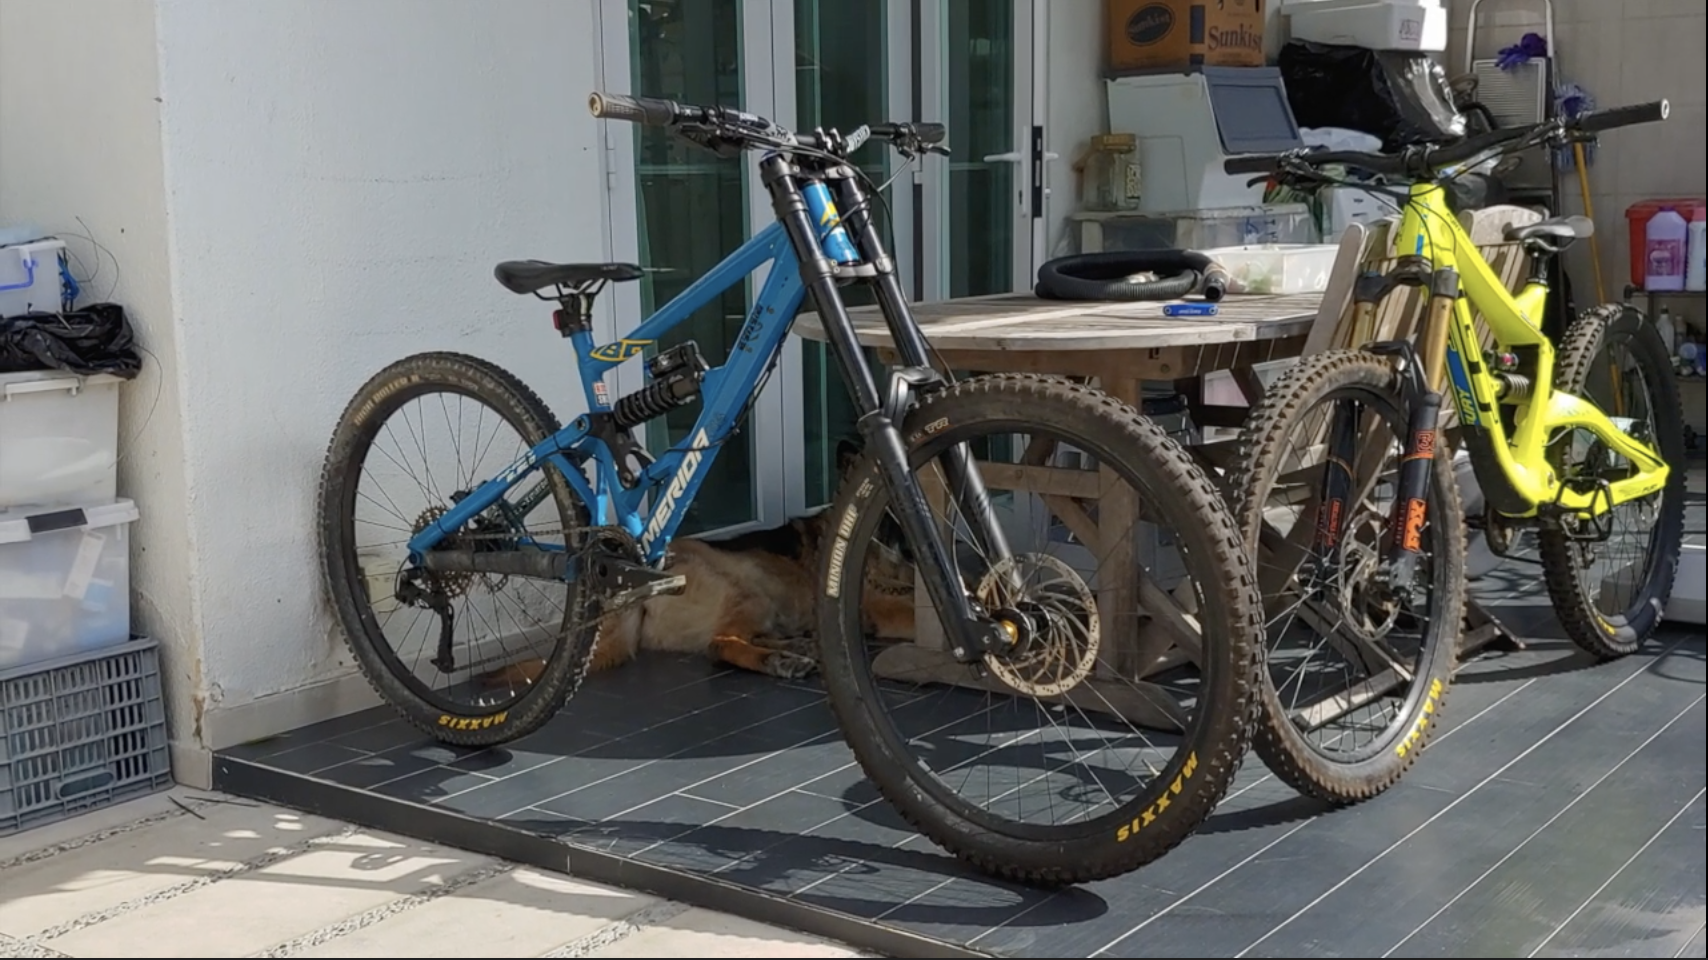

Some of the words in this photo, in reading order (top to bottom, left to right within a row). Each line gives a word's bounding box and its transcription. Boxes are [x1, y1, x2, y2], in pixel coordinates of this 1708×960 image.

[1207, 23, 1263, 54] Sunkist
[641, 427, 710, 556] MERIDA
[1403, 499, 1426, 551] FOX
[826, 536, 848, 598] MINION
[438, 711, 508, 730] MAXXIS
[1396, 677, 1442, 757] MAXXIS
[1117, 750, 1198, 842] MAXXIS
